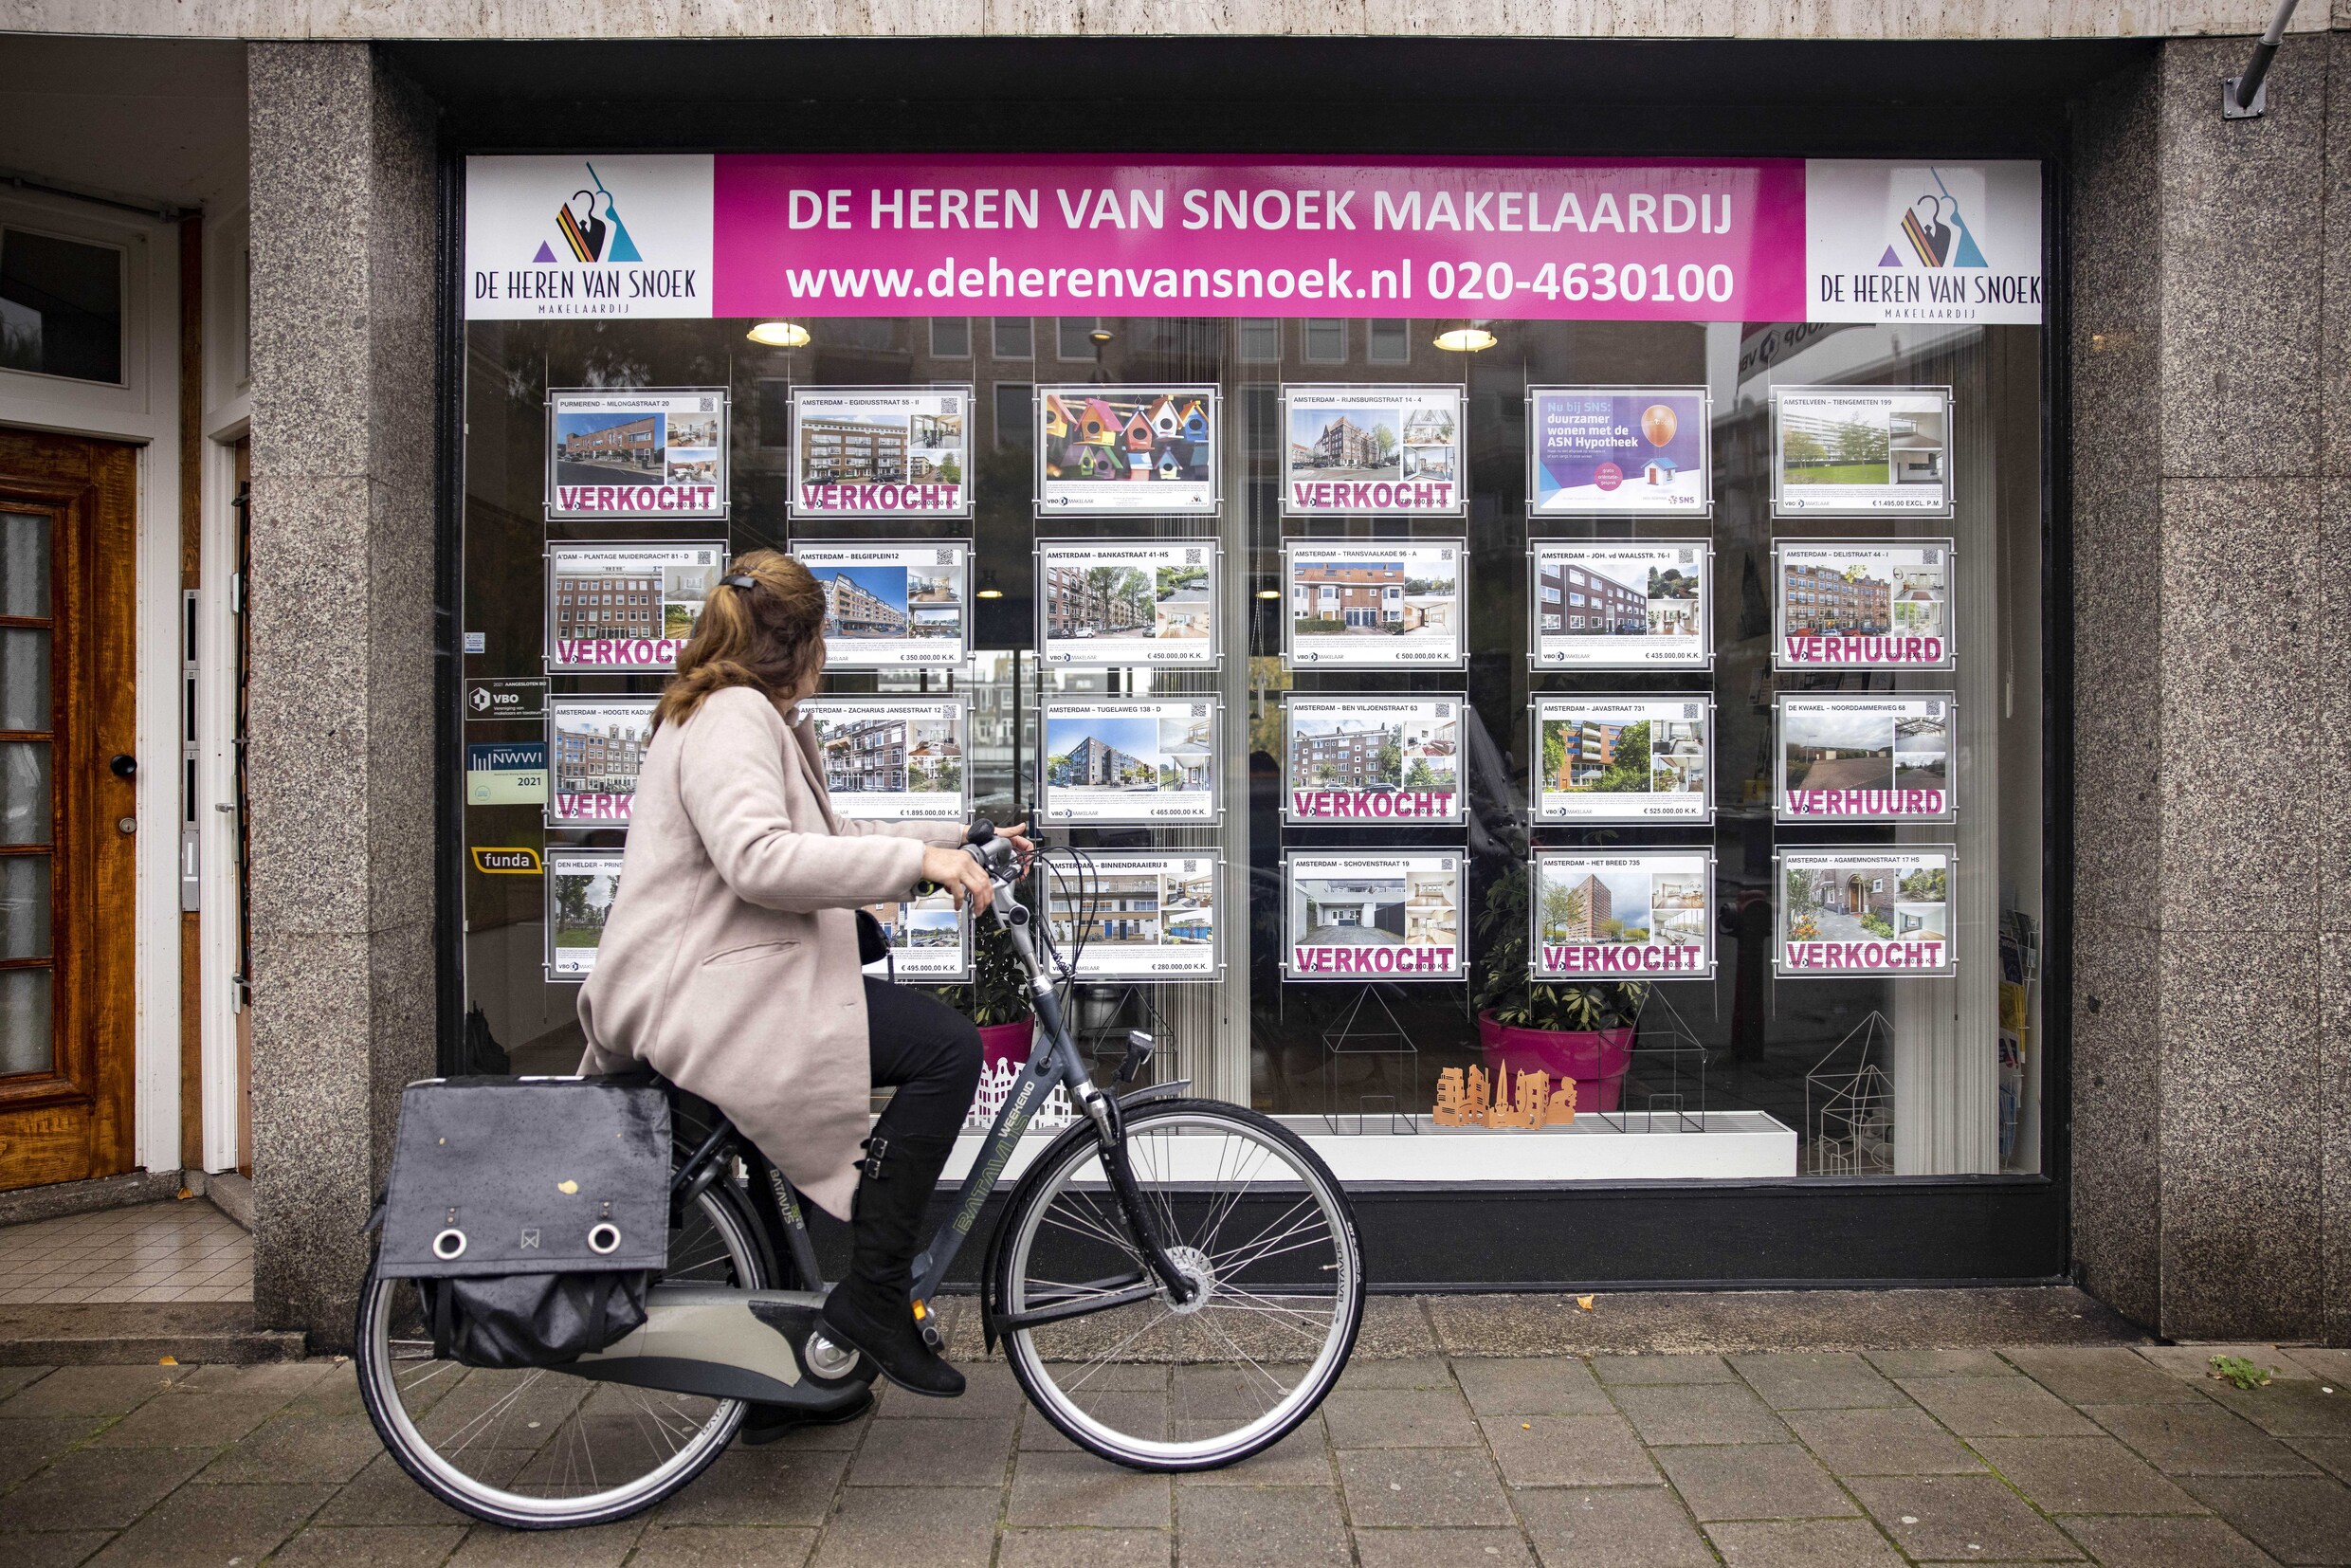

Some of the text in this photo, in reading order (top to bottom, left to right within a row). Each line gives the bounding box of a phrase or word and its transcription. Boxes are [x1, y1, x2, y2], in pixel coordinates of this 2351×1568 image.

[789, 189, 1732, 235] DE HEREN VAN SNOEK MAKELAARDIJ
[476, 269, 696, 299] DE HEREN VAN SNOEK
[785, 257, 1734, 302] www.deherenvansnoek.nl 020-4630100
[1821, 274, 2042, 304] DE HEREN VAN SNOEK
[538, 303, 629, 314] MAKELAARDIJ
[1885, 308, 1977, 319] MAKELAARDIJ
[1547, 402, 1612, 414] Nu bij SNS:
[1547, 413, 1610, 424] duurzamer
[1547, 425, 1629, 435] wonen met de
[1547, 436, 1639, 449] ASN Hypotheek
[559, 486, 714, 510] VERKOCHT
[802, 485, 958, 509] VERKOCHT
[1294, 483, 1451, 507] VERKOCHT
[556, 639, 692, 664] VERKOCH
[1787, 637, 1941, 662] VERHUURD
[493, 694, 519, 703] VBO
[493, 752, 541, 763] NWWI
[518, 777, 541, 786] 2021
[557, 794, 635, 818] VERK
[1294, 793, 1451, 816] VERKOCHT
[1788, 790, 1942, 814] VERHUURD
[484, 853, 530, 866] funda
[1295, 948, 1453, 972] VERKOCHT
[1543, 946, 1700, 971] VERKOCHT
[1787, 942, 1941, 968] VERKOCHT
[998, 1080, 1035, 1138] WEEKEND
[952, 1114, 1030, 1235] BATAVUS
[770, 1169, 794, 1224] BATAVUS
[1336, 1242, 1345, 1303] BATAVUS
